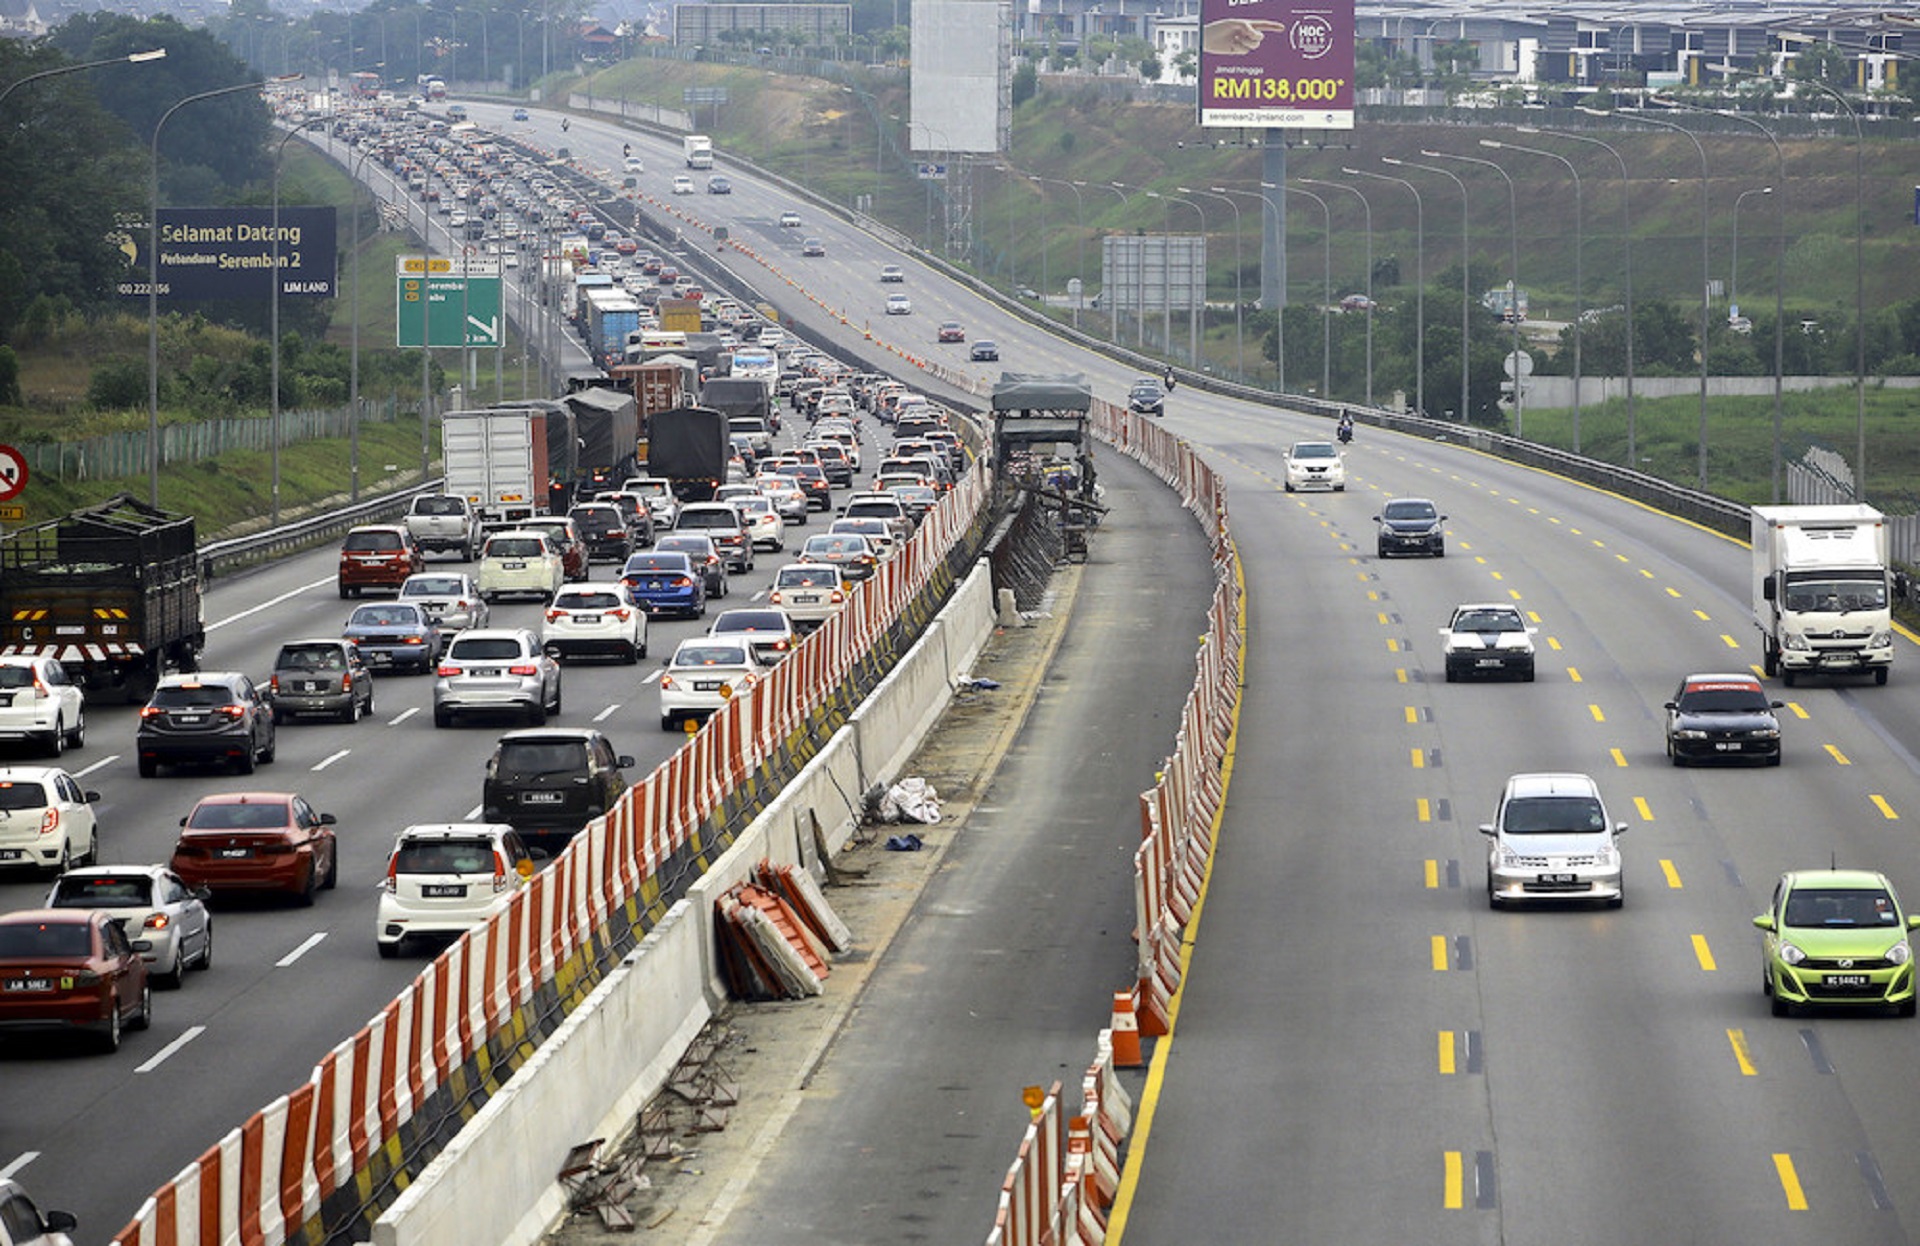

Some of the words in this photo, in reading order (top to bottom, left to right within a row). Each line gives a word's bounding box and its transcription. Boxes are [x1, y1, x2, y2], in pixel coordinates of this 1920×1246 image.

[1299, 25, 1325, 37] HOC
[162, 225, 234, 242] Selamat
[237, 224, 301, 245] Datang
[290, 252, 301, 268] 2
[303, 282, 328, 292] LAND
[22, 627, 33, 640] C
